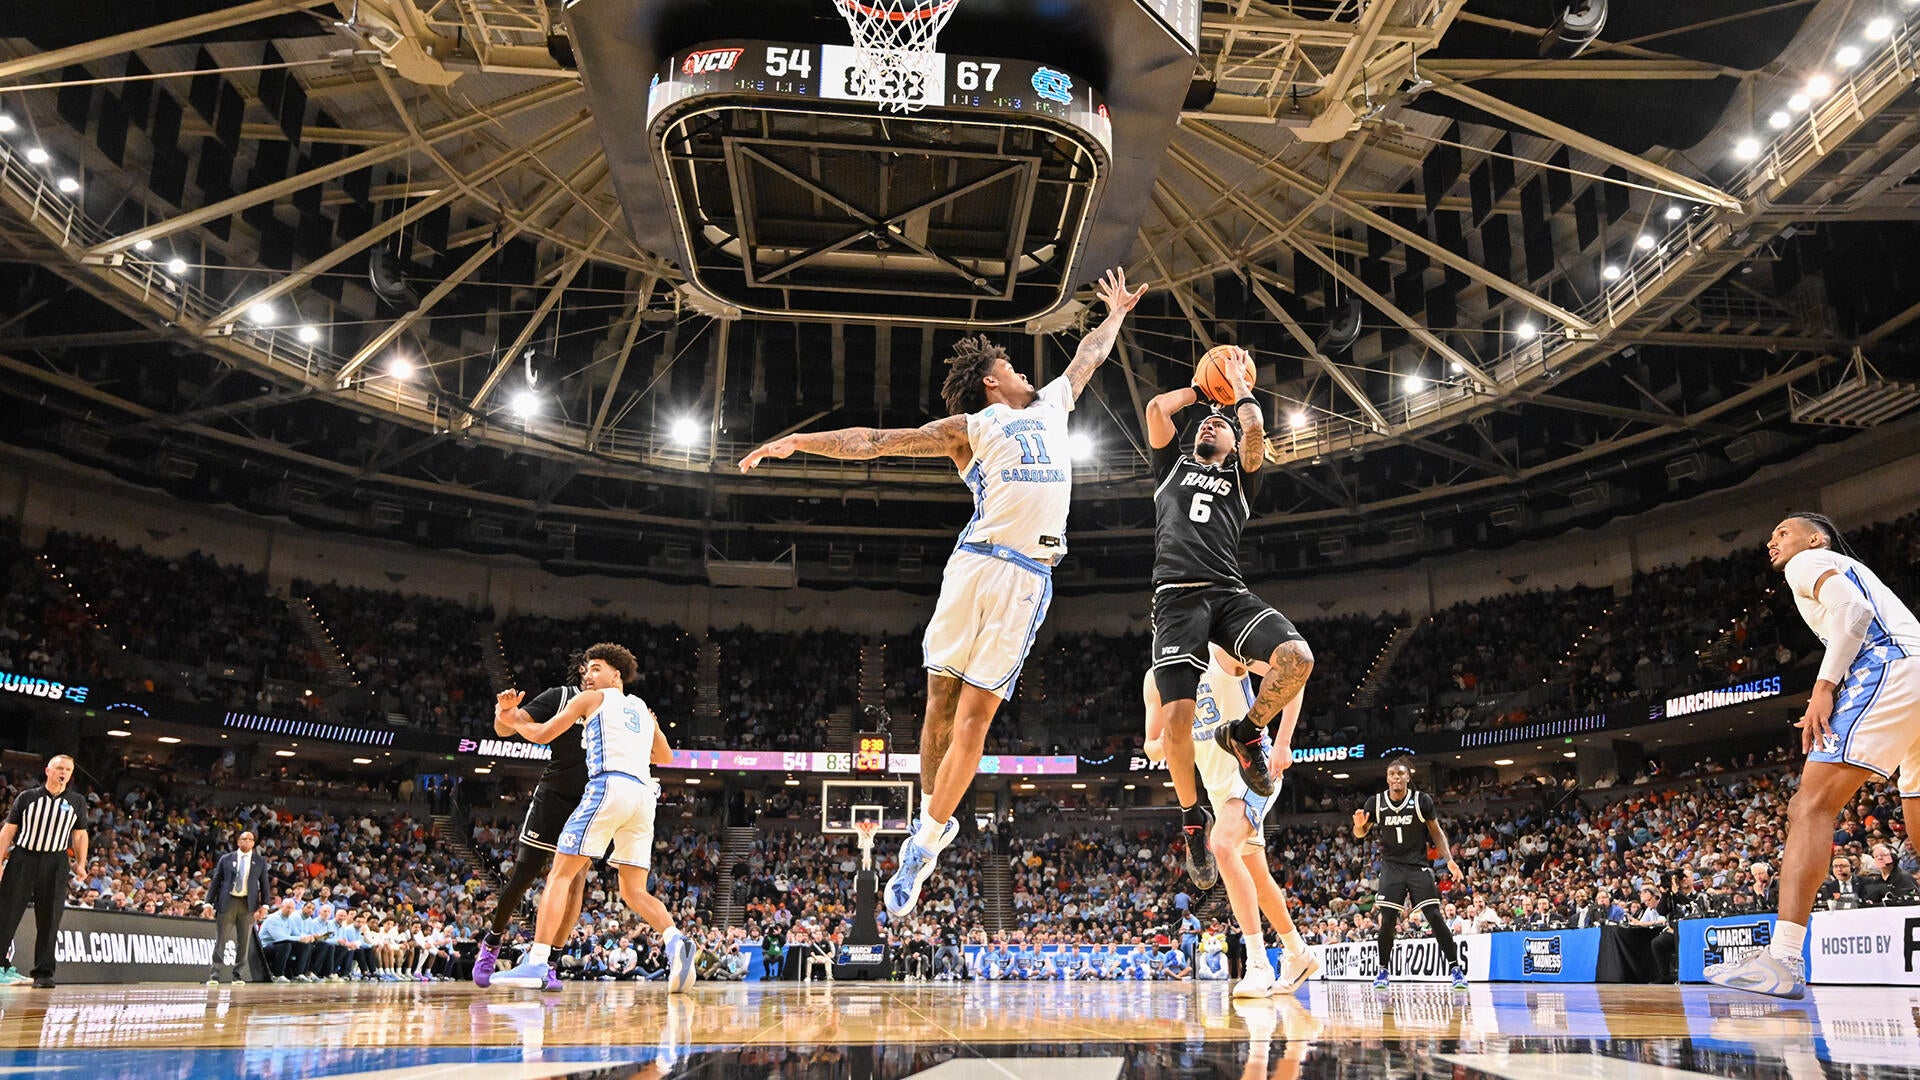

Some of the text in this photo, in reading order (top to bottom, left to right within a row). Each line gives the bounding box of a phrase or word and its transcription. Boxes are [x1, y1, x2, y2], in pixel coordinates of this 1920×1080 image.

[692, 52, 737, 74] VCU
[766, 47, 811, 78] 54
[957, 61, 1000, 91] 67
[1002, 419, 1046, 438] NORTH
[1015, 434, 1051, 464] 11
[1180, 472, 1232, 496] RAMS
[1189, 493, 1213, 523] 6
[1162, 646, 1180, 655] VCU
[623, 707, 640, 733] 3
[478, 739, 552, 760] MARCHMA
[1292, 745, 1348, 764] OUNDS
[783, 753, 808, 770] 54
[1385, 815, 1412, 826] RAMS
[527, 830, 540, 839] VCU
[1395, 827, 1403, 844] 1
[1530, 940, 1550, 954] MARCH
[1717, 928, 1752, 947] MARCH
[1822, 935, 1891, 955] HOSTED BY
[848, 946, 872, 954] MARCH
[851, 953, 883, 962] MADNESS
[1325, 946, 1350, 976] FIRST
[1360, 944, 1402, 976] SECND
[1405, 940, 1468, 976] ROUNS
[1533, 954, 1561, 968] MADNESS
